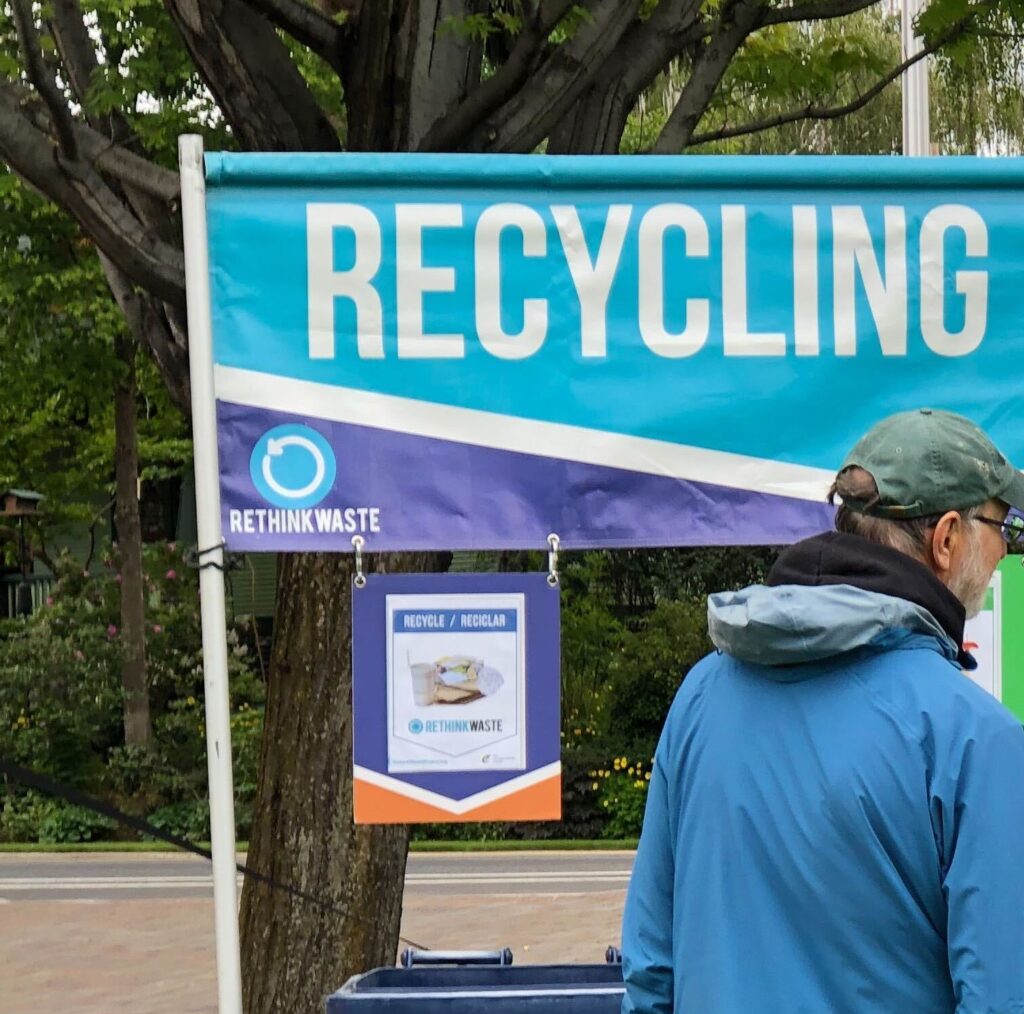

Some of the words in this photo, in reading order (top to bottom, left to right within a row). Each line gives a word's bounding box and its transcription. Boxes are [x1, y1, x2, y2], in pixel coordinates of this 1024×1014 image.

[305, 202, 990, 360] RECYCLING
[403, 614, 445, 628] RECYCLE
[460, 613, 506, 628] RECICLAR
